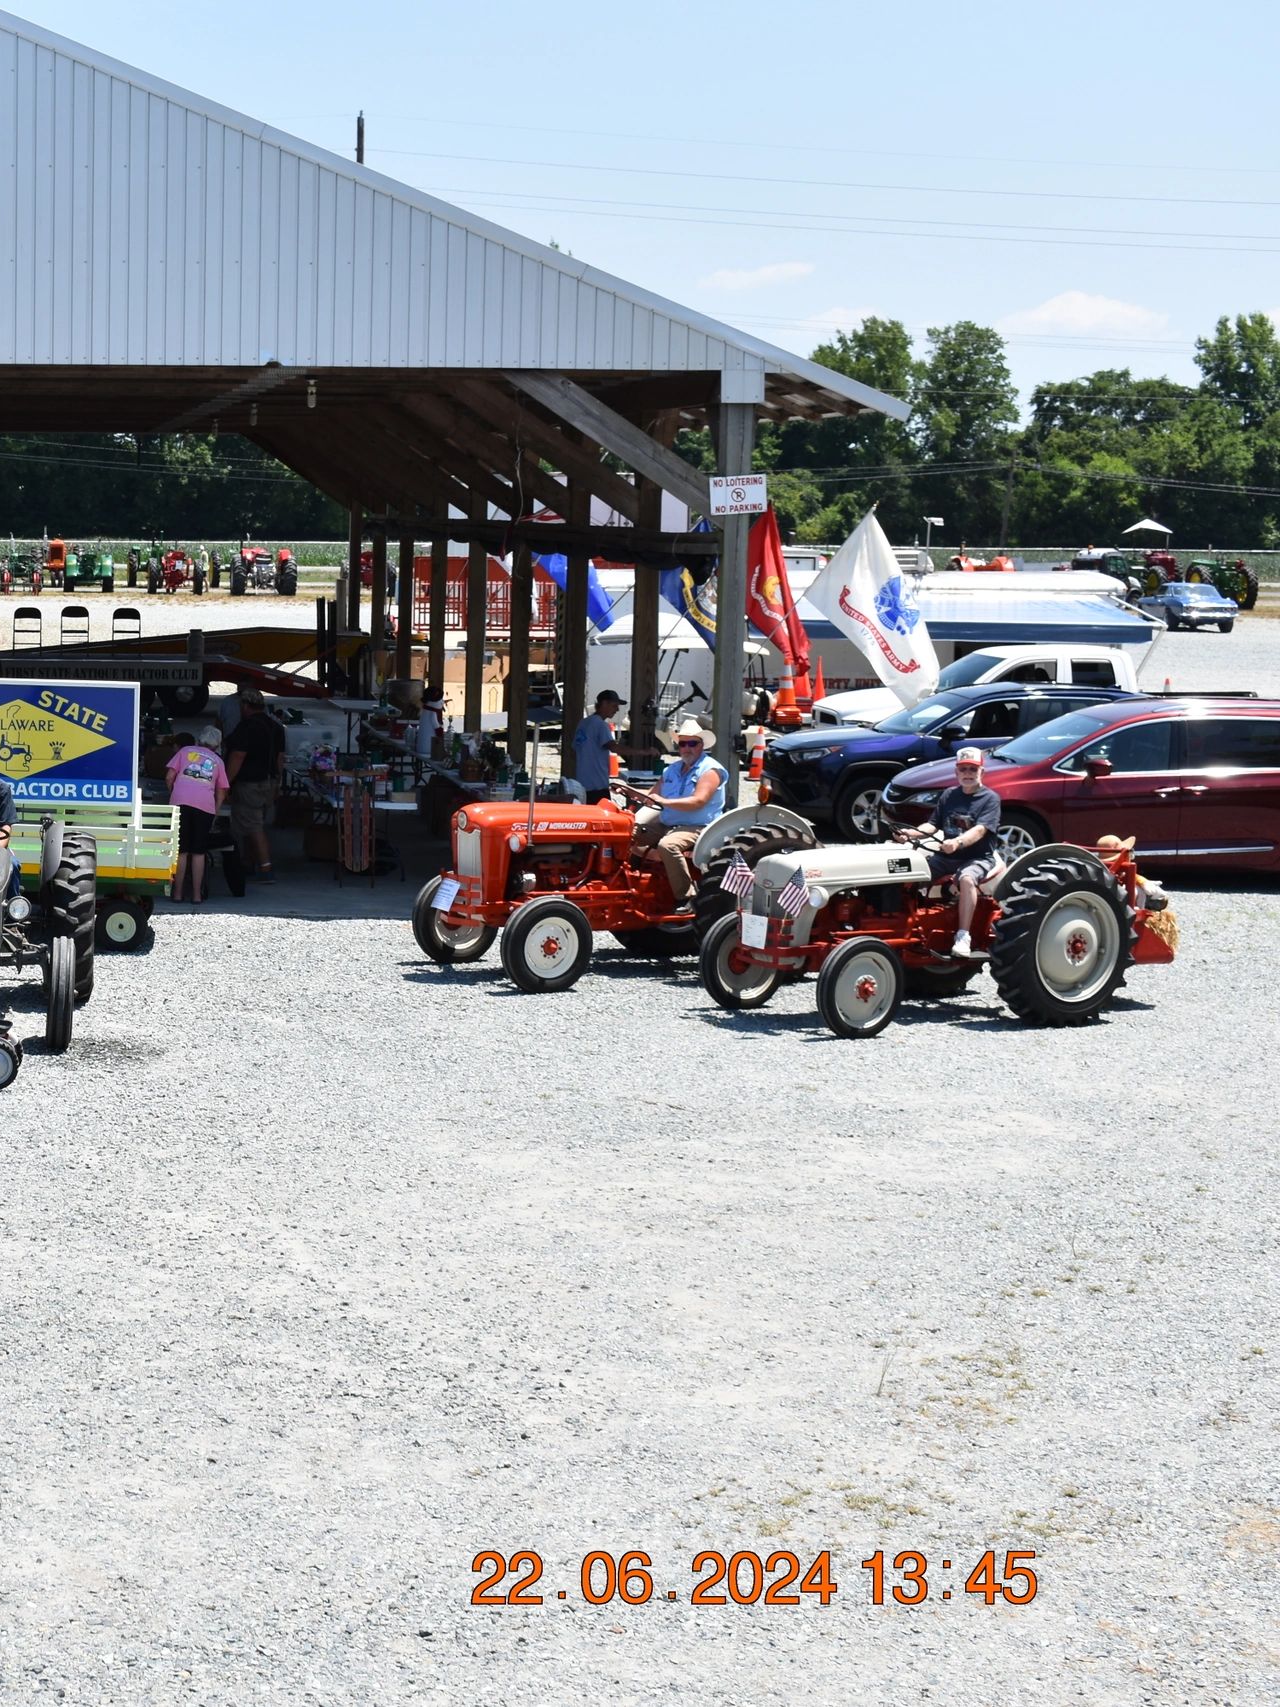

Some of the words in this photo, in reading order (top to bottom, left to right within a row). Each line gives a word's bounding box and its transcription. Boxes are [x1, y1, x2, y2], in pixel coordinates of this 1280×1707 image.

[713, 479, 723, 487] NO
[726, 477, 763, 487] LOITERING
[729, 503, 763, 512] PARKING
[841, 602, 865, 621] UNITED
[866, 621, 888, 649] STATES
[885, 649, 906, 671] ARMY
[5, 667, 35, 678] FIRST
[39, 667, 70, 679] STATE
[72, 667, 119, 680] ANTIQUE
[120, 668, 170, 680] TRACTOR
[171, 668, 199, 681] CLUB
[38, 690, 109, 732] STATE
[8, 782, 77, 797] RACTOR
[81, 784, 129, 799] CLUB
